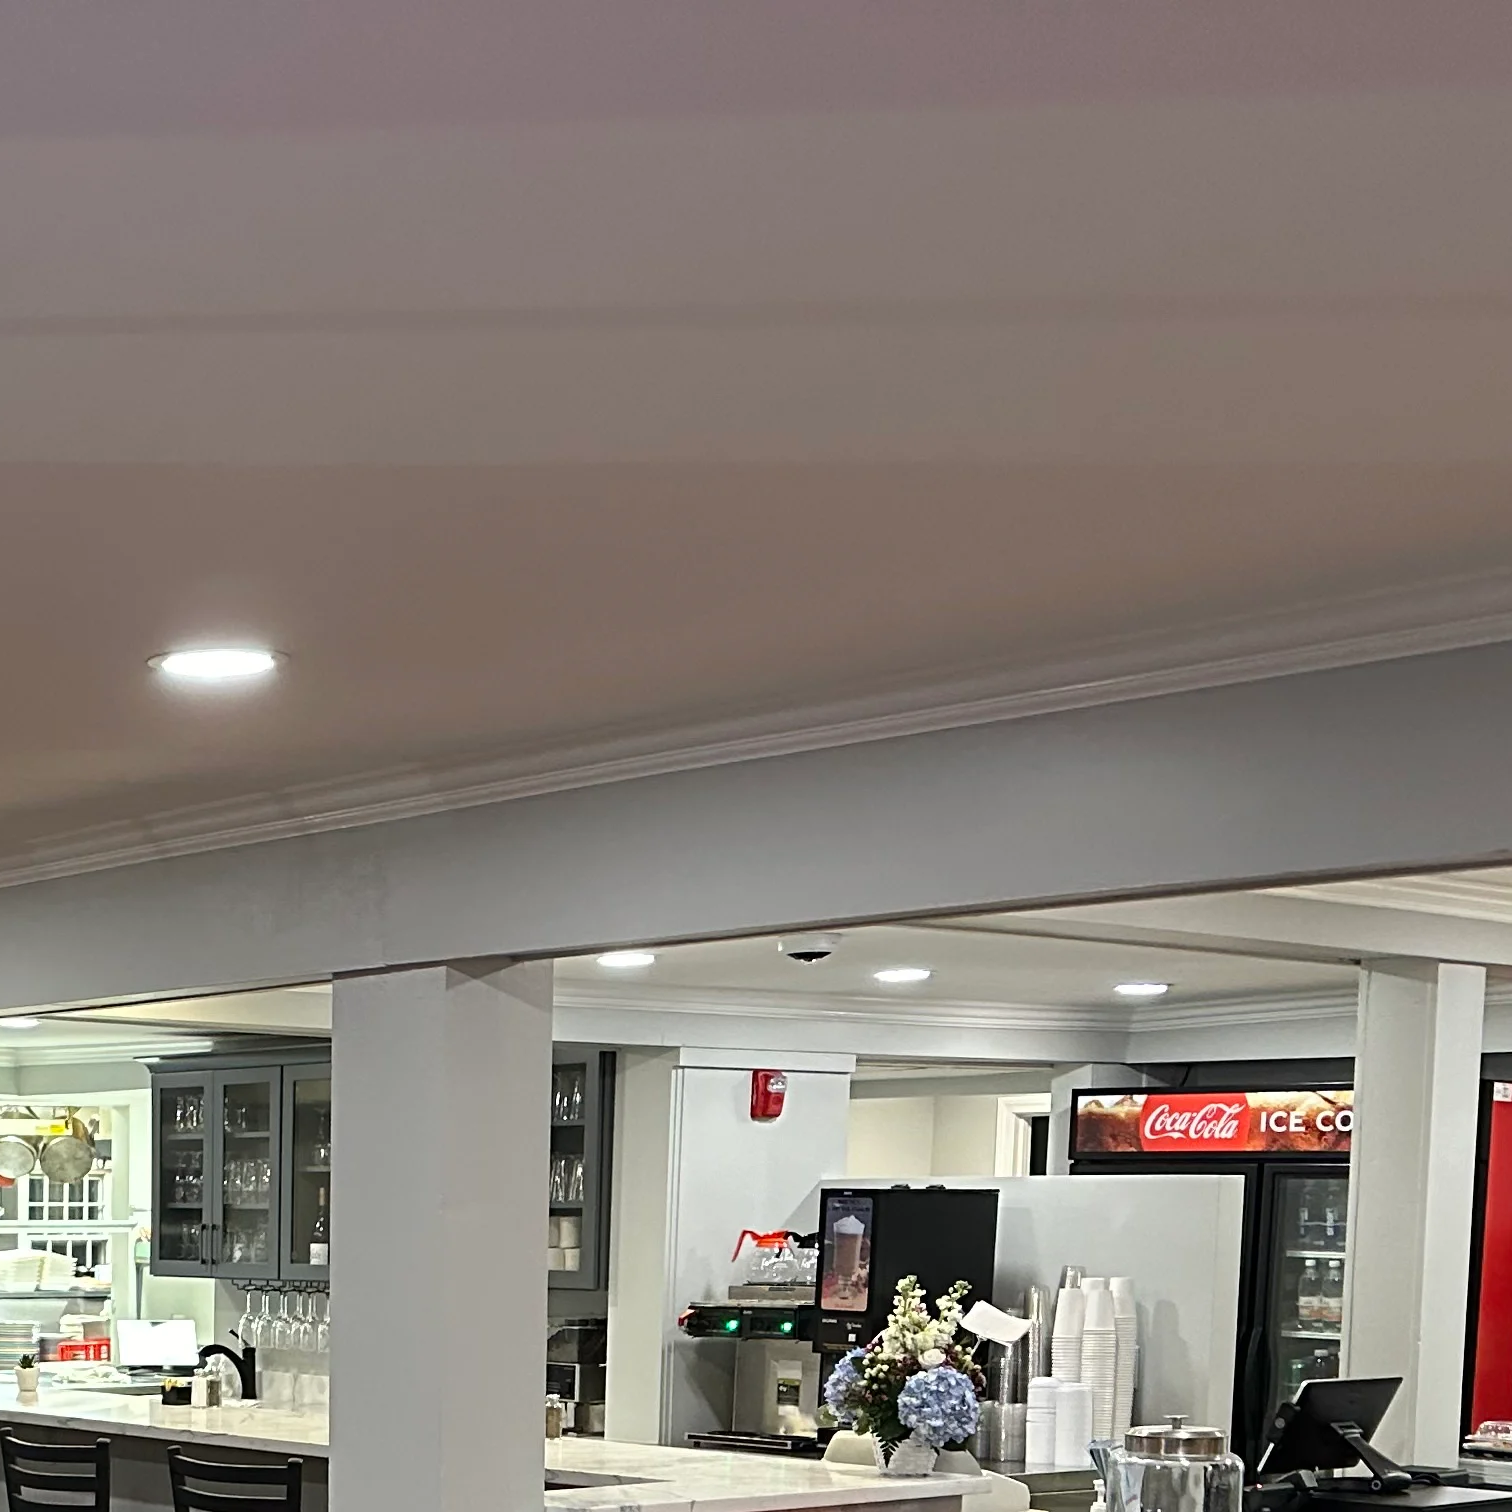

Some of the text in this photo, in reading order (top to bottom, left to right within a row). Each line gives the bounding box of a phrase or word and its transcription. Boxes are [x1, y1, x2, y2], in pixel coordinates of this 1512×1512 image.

[1144, 1103, 1246, 1140] Coca-Cola
[1260, 1110, 1354, 1133] ICE CO
